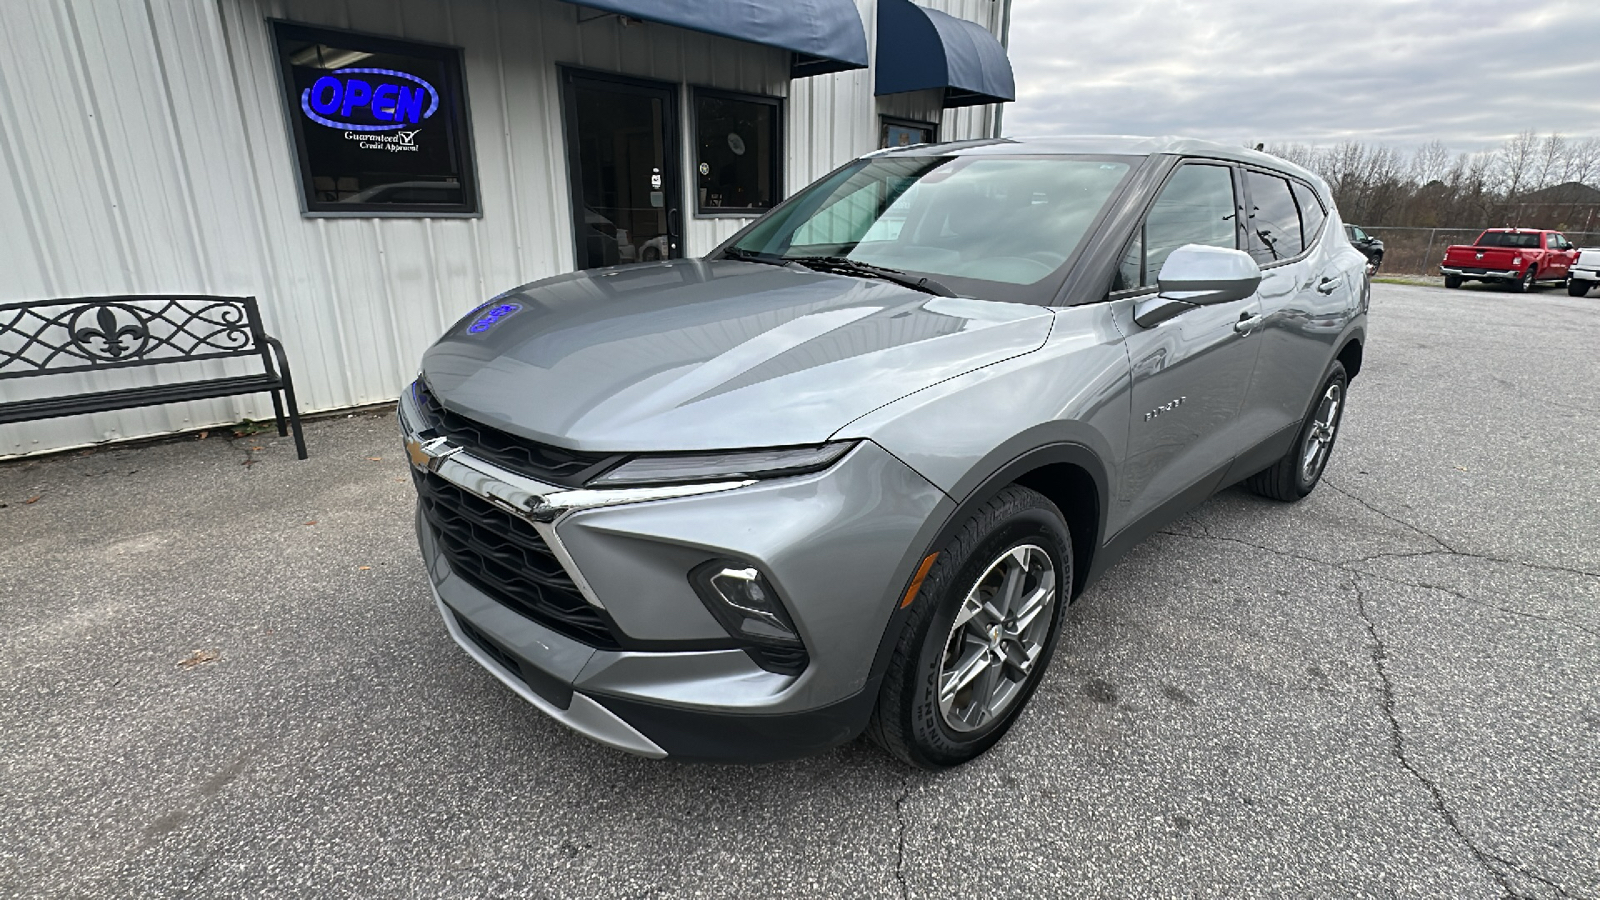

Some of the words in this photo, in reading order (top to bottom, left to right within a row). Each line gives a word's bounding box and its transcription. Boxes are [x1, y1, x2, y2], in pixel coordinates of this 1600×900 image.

[311, 76, 425, 123] OPEN
[344, 131, 399, 142] Guaranteed
[359, 141, 384, 150] Credit
